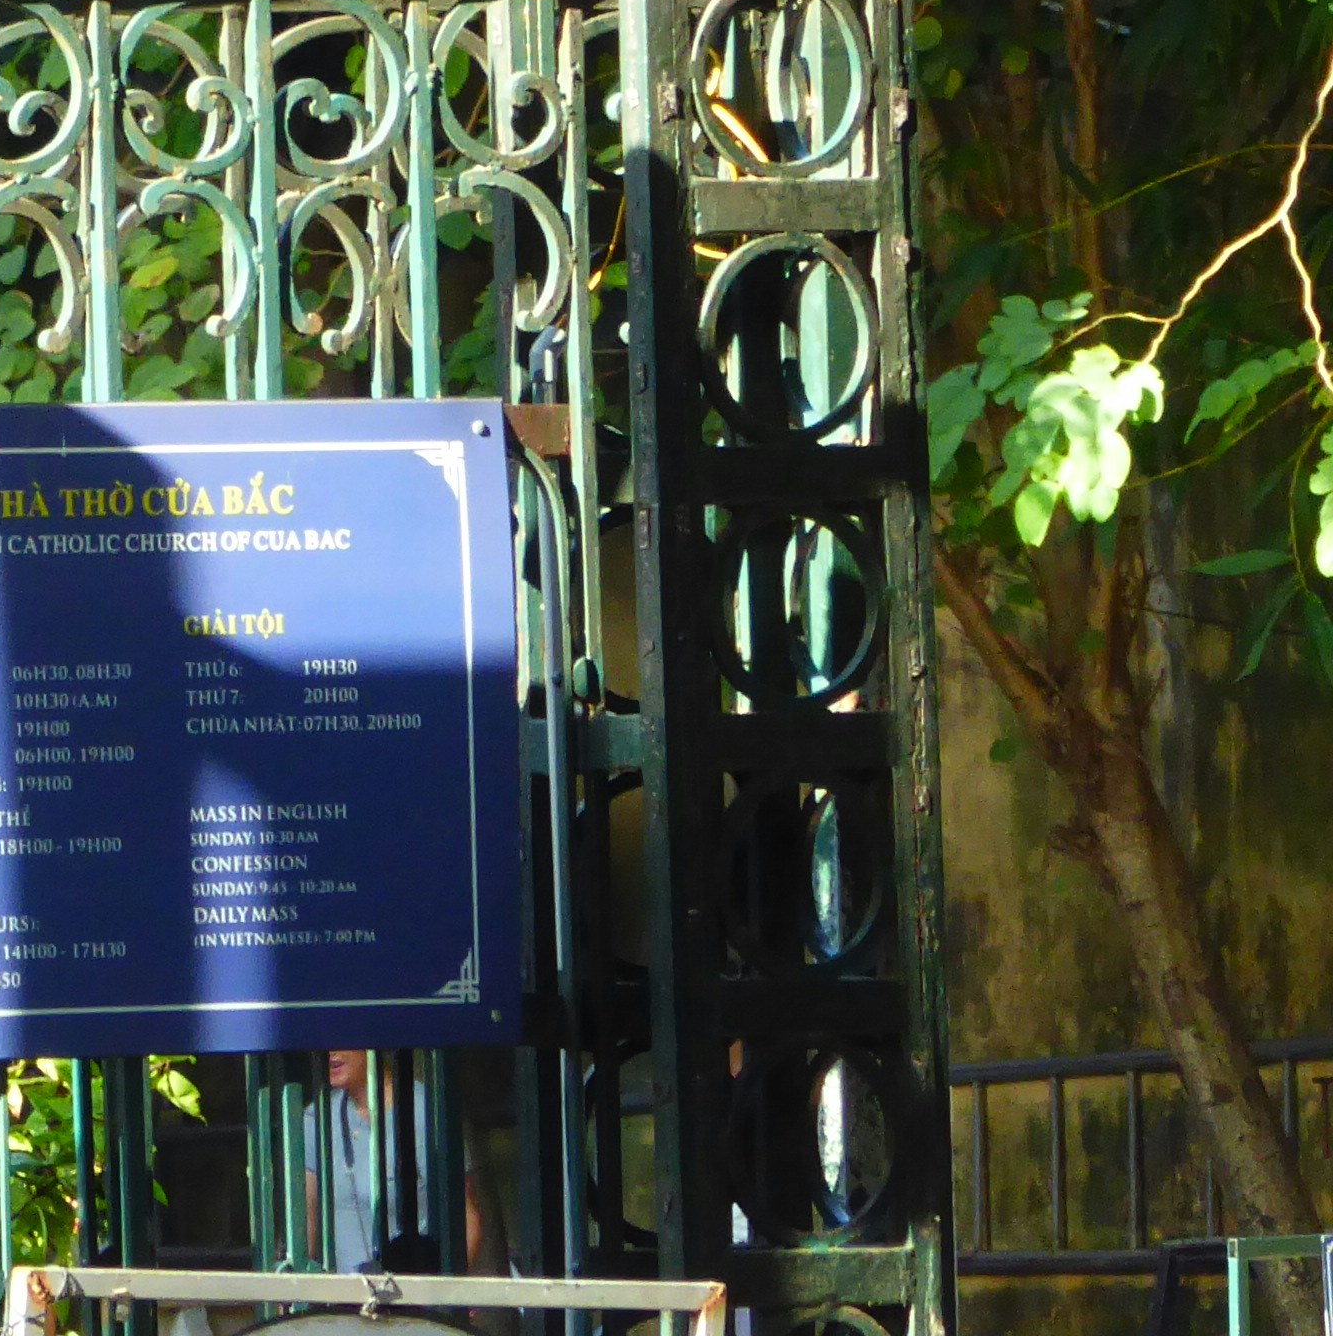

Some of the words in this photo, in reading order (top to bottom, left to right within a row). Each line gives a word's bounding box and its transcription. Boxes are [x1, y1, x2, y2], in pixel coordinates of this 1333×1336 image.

[59, 480, 135, 518] THỜ
[142, 478, 215, 517] CỬA
[223, 471, 294, 516] BẮC
[7, 534, 120, 555] CATHOLIC
[125, 530, 217, 554] CHURCH
[221, 531, 251, 552] OF
[253, 530, 301, 551] CUA
[305, 529, 351, 550] BAC
[241, 608, 285, 639] TỘI
[76, 663, 132, 680] 08H30
[303, 659, 357, 676] 19H30
[15, 693, 69, 709] 10H30
[303, 687, 359, 704] 20H00
[16, 720, 70, 737] 19H00
[367, 714, 421, 730] 20H00
[80, 746, 135, 762] 19H00
[17, 776, 73, 792] 19H00
[190, 805, 237, 823] MASS
[241, 804, 261, 821] IN
[267, 803, 348, 821] ENGLISH
[0, 838, 53, 856] 18H00
[69, 838, 122, 854] 19H00
[190, 832, 256, 847] SUNDAY:
[297, 831, 319, 844] AM
[191, 854, 308, 874] CONFESSION
[192, 882, 258, 897] SUNDAY:
[337, 881, 357, 893] AM
[193, 906, 249, 924] DAILY
[252, 906, 298, 922] MASS
[193, 932, 217, 948] (IN
[354, 929, 375, 943] PM
[3, 943, 57, 960] 14H00
[73, 942, 126, 959] 17H30
